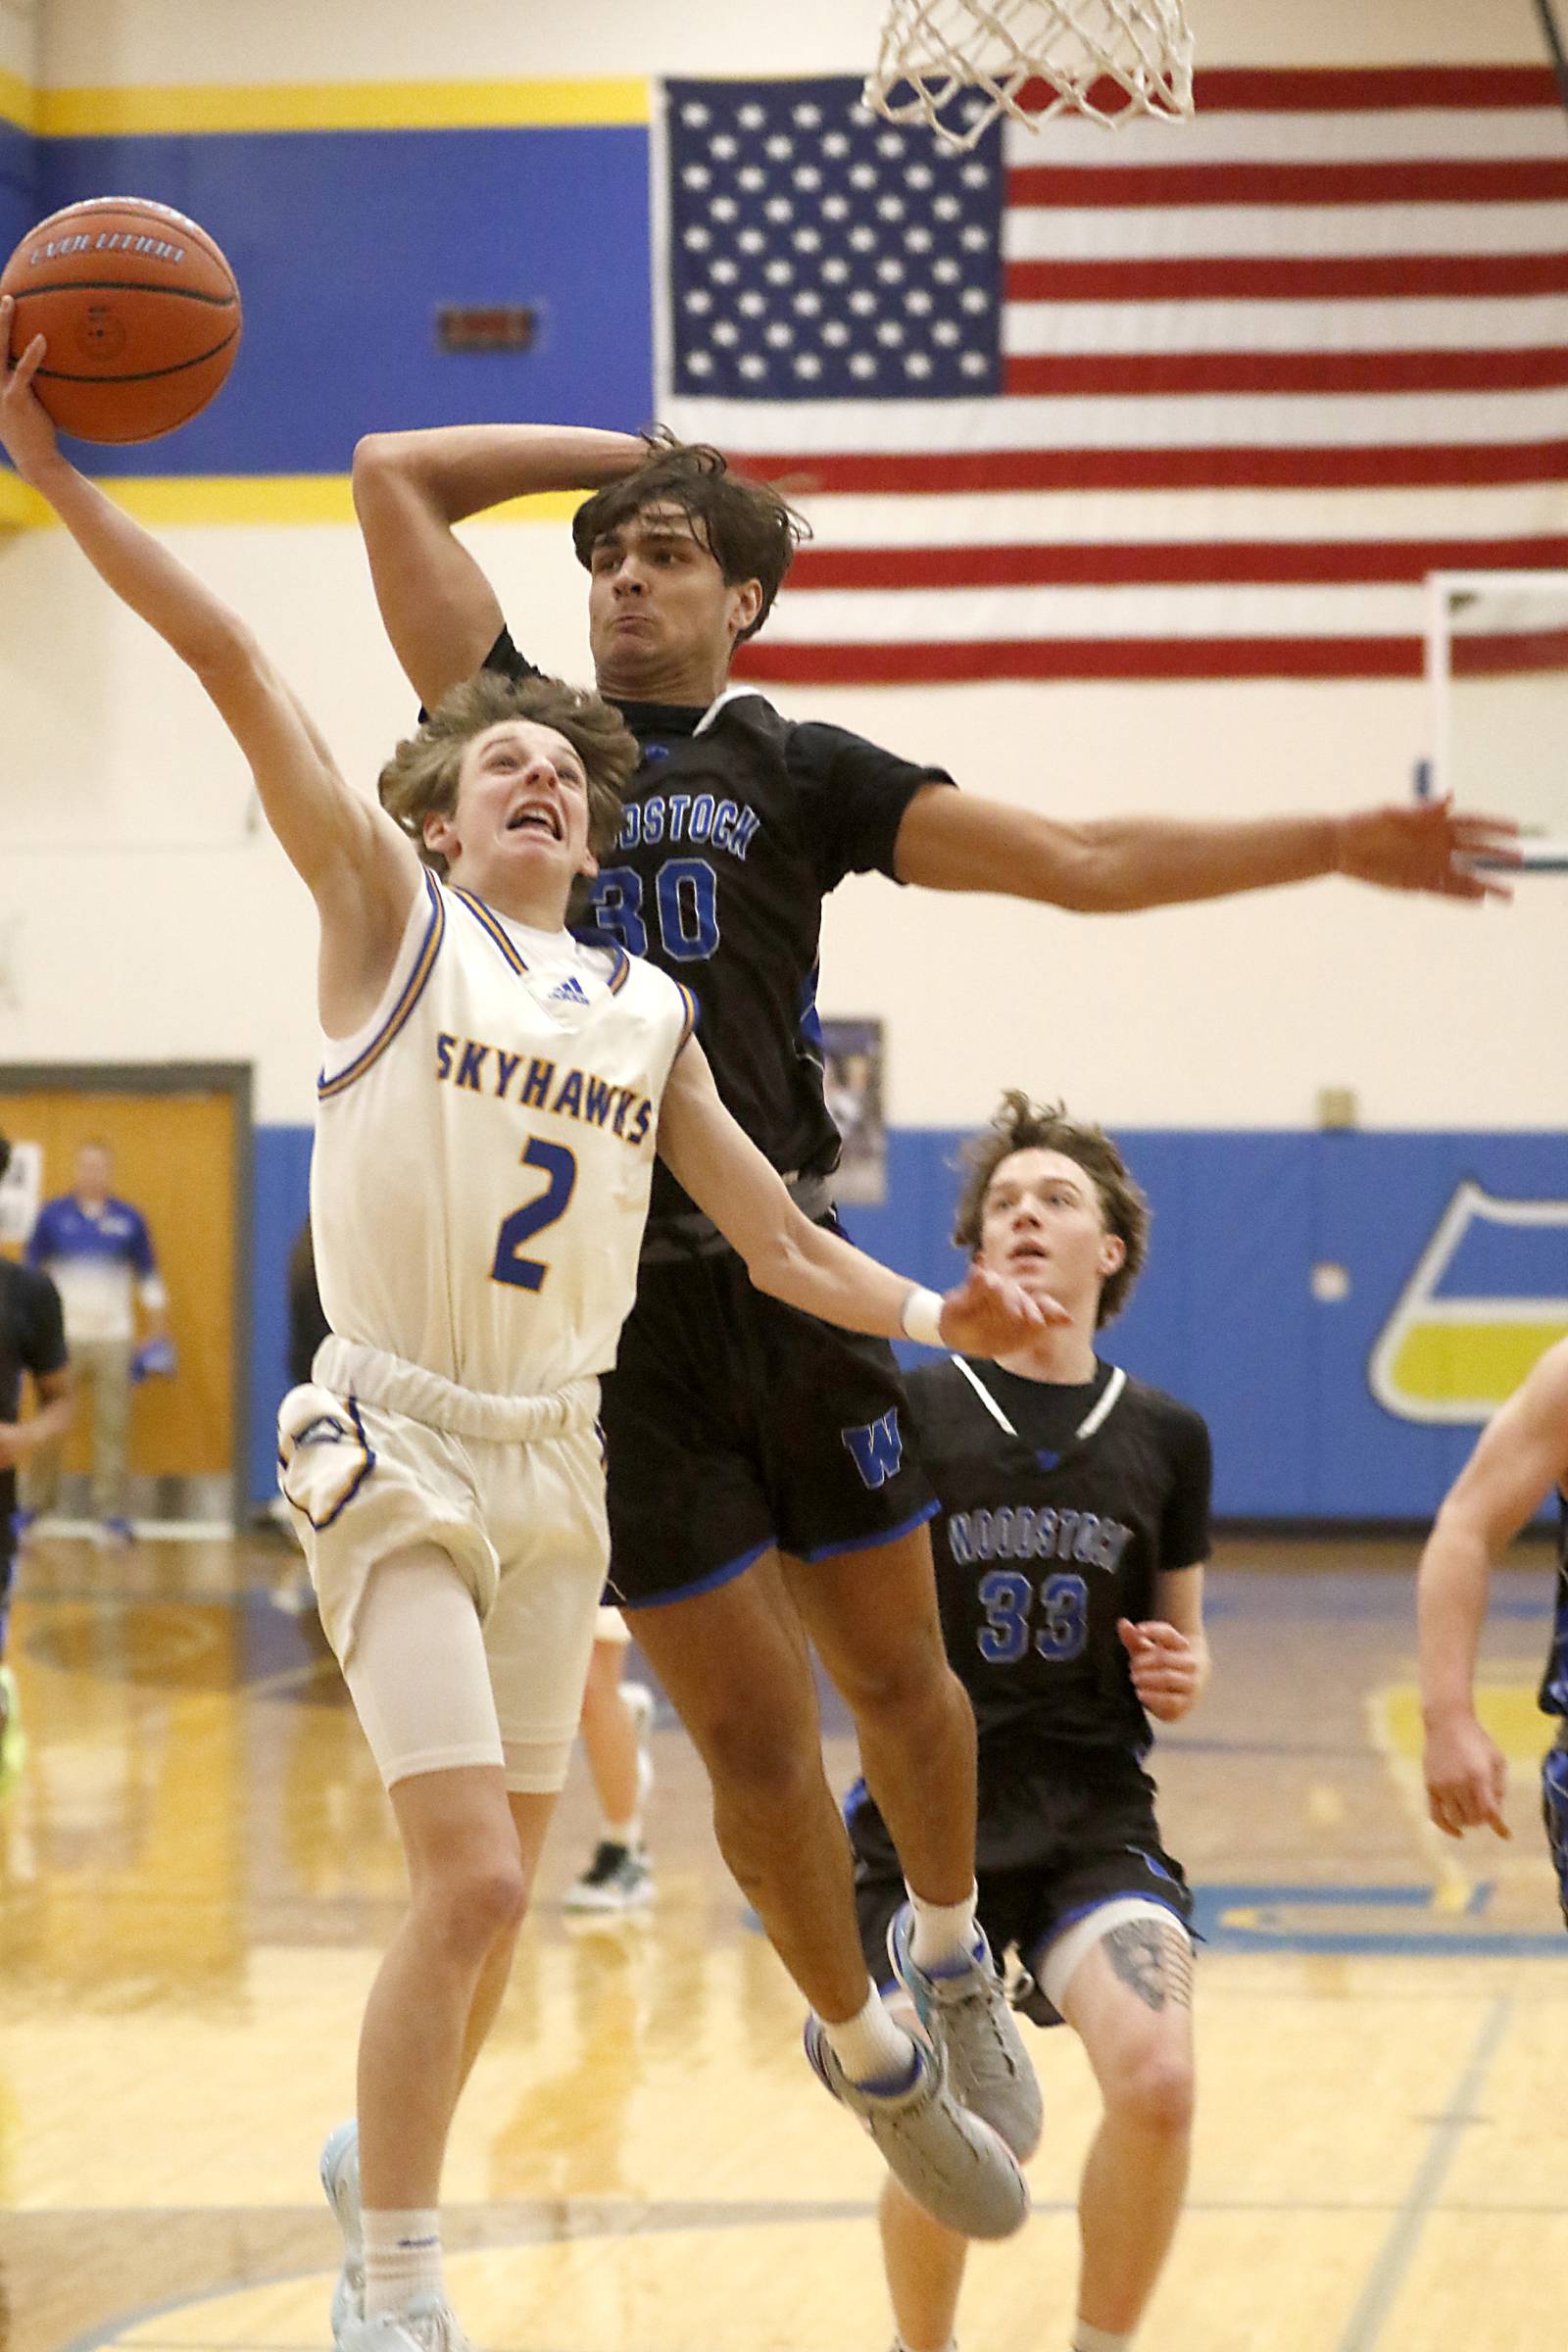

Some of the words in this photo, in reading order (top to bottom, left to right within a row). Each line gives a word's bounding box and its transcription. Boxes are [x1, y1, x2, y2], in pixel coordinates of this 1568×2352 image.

[590, 857, 720, 962] 30
[435, 1030, 654, 1147] SKYHAWKS
[489, 1134, 579, 1295] 2
[841, 1405, 903, 1490] W
[977, 1570, 1089, 1663] 33
